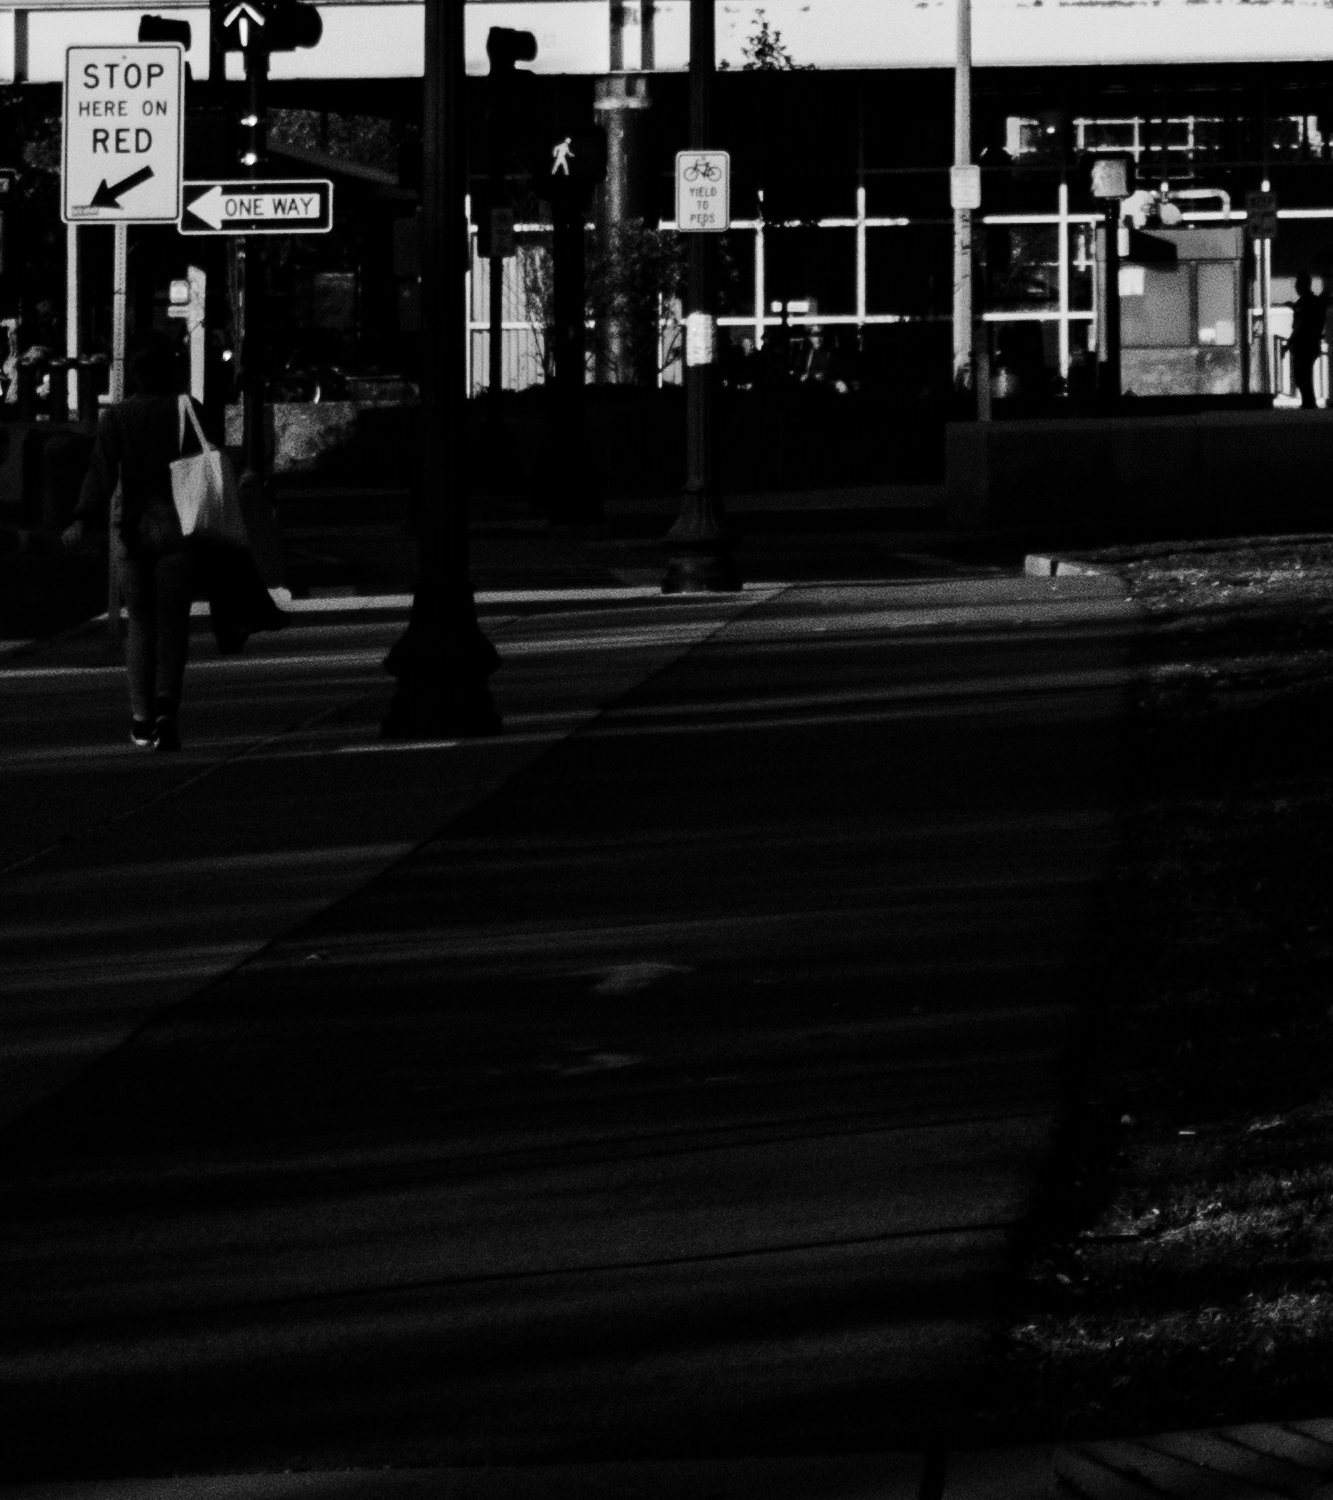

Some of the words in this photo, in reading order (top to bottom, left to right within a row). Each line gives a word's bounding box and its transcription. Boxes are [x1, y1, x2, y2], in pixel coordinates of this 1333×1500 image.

[83, 63, 164, 89] STOP
[78, 101, 128, 117] HERE
[142, 101, 167, 116] ON
[92, 128, 153, 153] RED
[689, 186, 717, 197] YIELD
[225, 198, 264, 217] ONE
[272, 197, 313, 216] WAY
[697, 200, 709, 210] TO
[690, 213, 716, 223] PEDS
